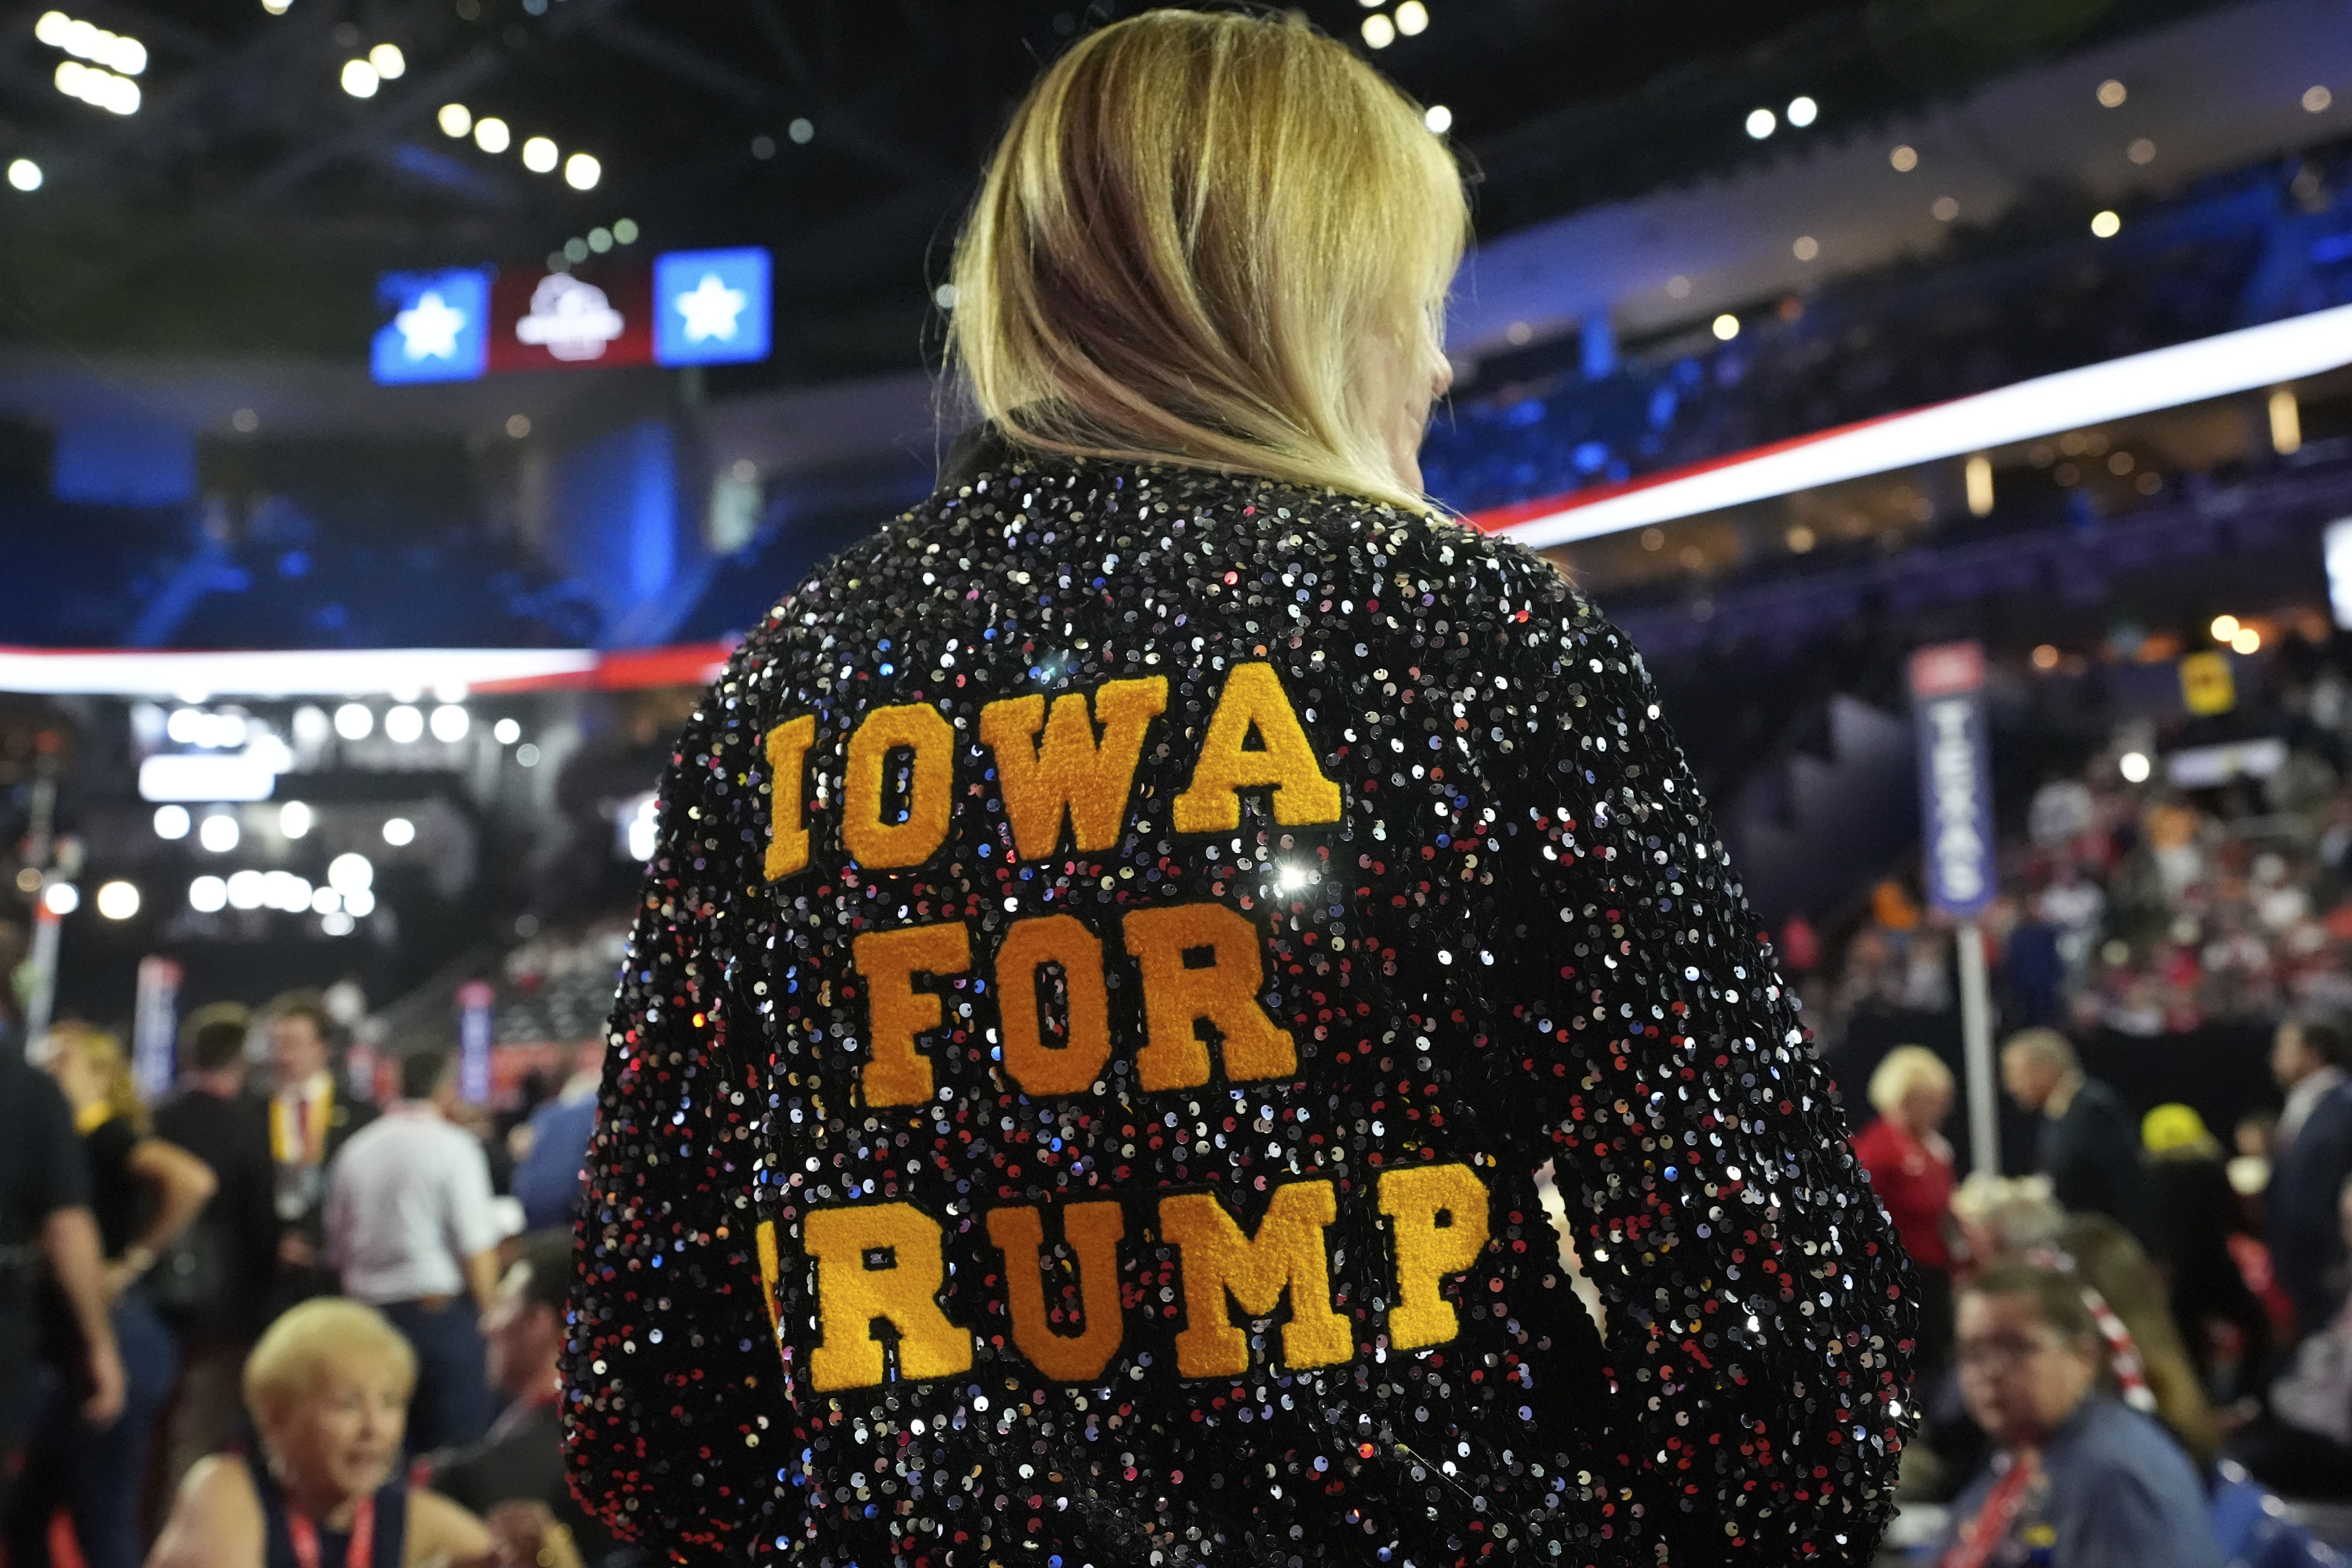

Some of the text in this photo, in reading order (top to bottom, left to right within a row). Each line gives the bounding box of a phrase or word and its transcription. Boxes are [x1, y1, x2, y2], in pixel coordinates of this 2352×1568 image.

[762, 662, 1342, 882] IOWA
[852, 903, 1297, 1107] FOR
[756, 1163, 1490, 1392] RUMP
